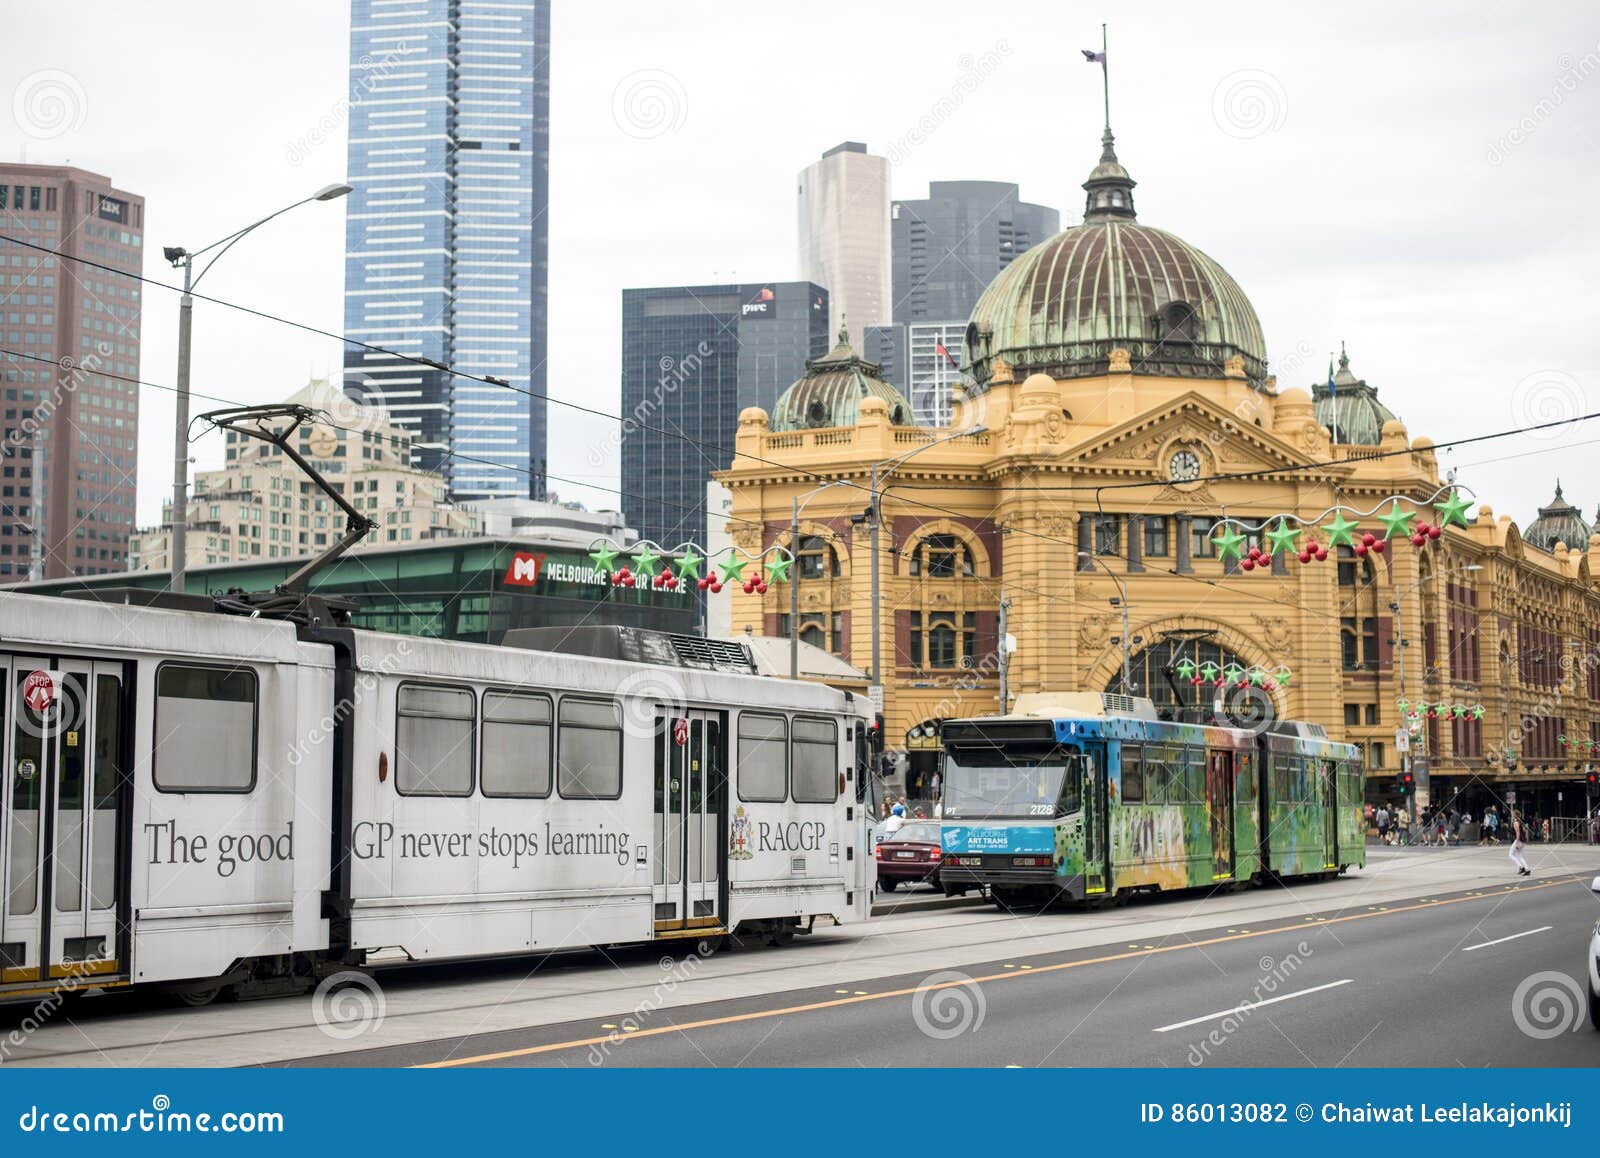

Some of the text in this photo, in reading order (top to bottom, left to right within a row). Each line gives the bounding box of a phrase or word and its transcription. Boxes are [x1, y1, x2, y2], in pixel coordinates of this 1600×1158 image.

[742, 303, 768, 315] pwc
[30, 675, 50, 687] STOP
[1030, 804, 1054, 815] 2128
[758, 821, 826, 852] RACGP
[144, 819, 630, 877] The good GP never stops learning
